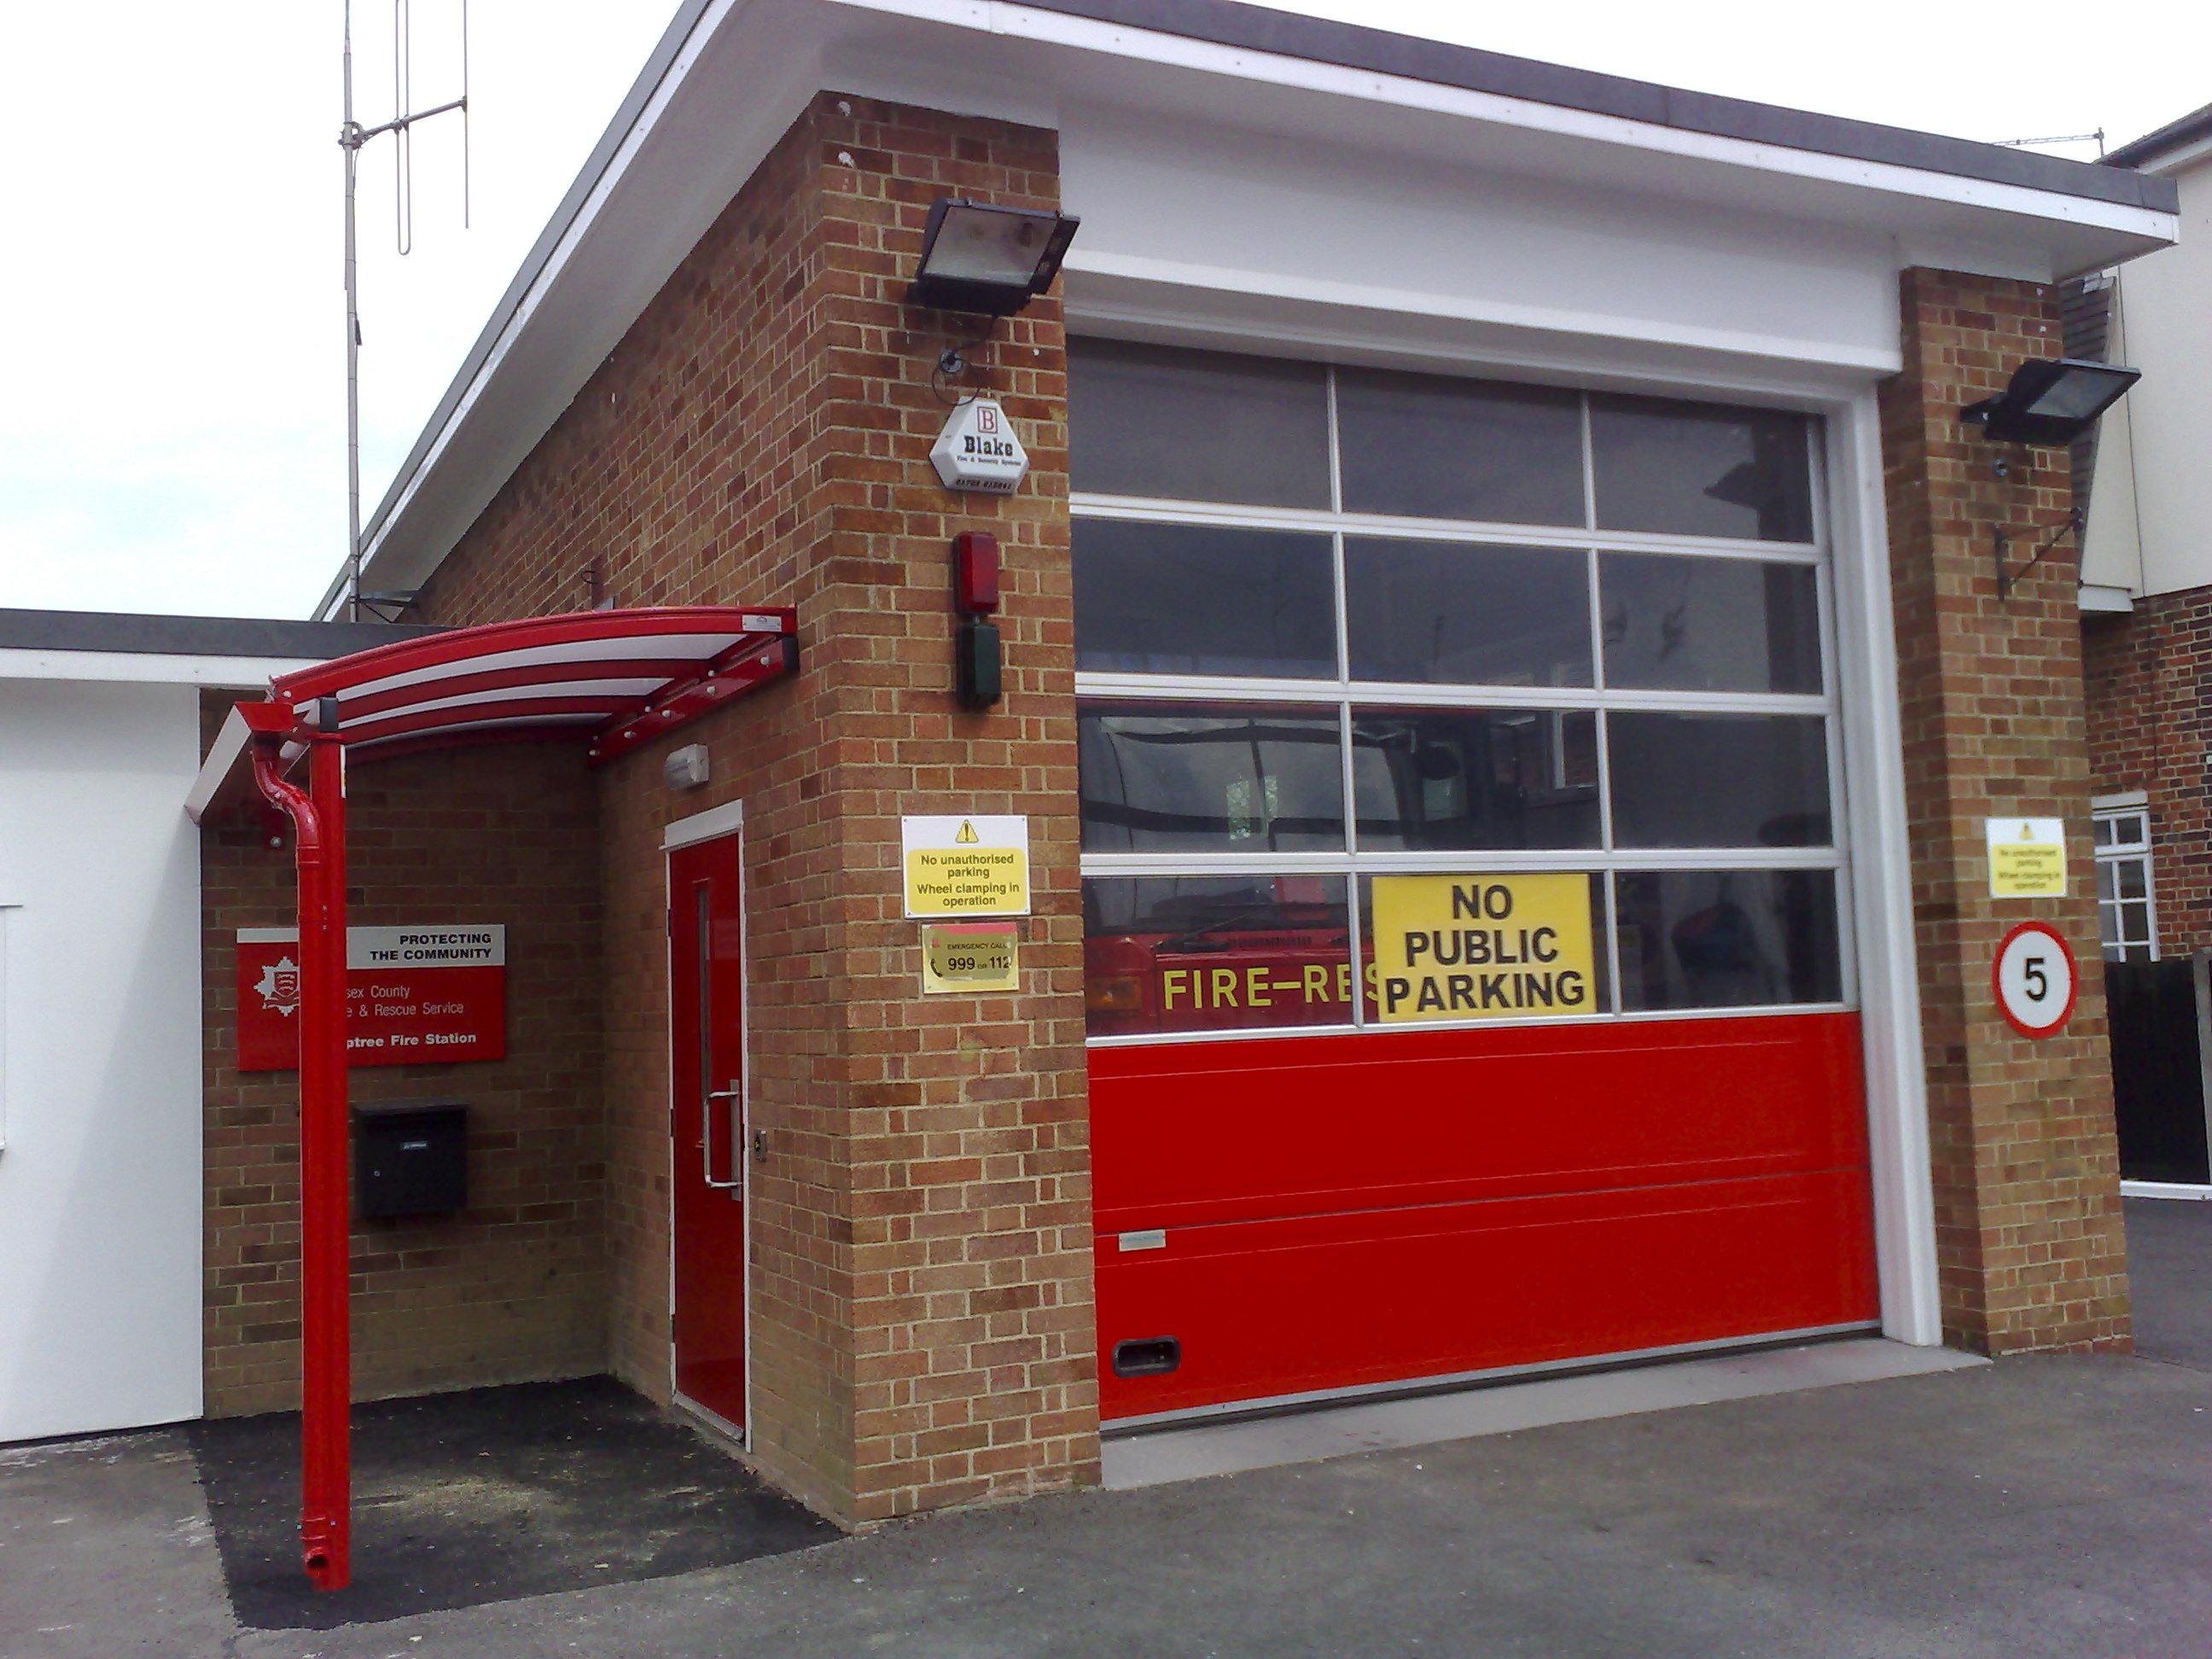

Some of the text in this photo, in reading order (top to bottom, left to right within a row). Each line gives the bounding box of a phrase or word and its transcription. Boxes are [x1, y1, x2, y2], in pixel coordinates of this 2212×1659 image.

[963, 435, 1014, 457] Blake
[921, 853, 1014, 865] No unauthorised
[947, 867, 990, 880] parking
[917, 882, 1020, 895] Wheel clamping in
[942, 896, 997, 909] operation
[1452, 884, 1512, 920] NO
[399, 933, 492, 946] PROTECTING
[1405, 927, 1558, 967] PUBLIC
[370, 947, 492, 961] THE COMMUNITY
[948, 957, 975, 970] 999
[990, 956, 1011, 969] 112
[1163, 963, 1378, 1010] FIRE-RES
[2025, 957, 2047, 1002] 5
[346, 985, 410, 999] sex County
[1385, 970, 1585, 1014] PARKING
[358, 1004, 369, 1017] &
[375, 1003, 416, 1016] Rescue
[422, 1001, 464, 1015] Service
[346, 1032, 476, 1050] ptree Fire Station
